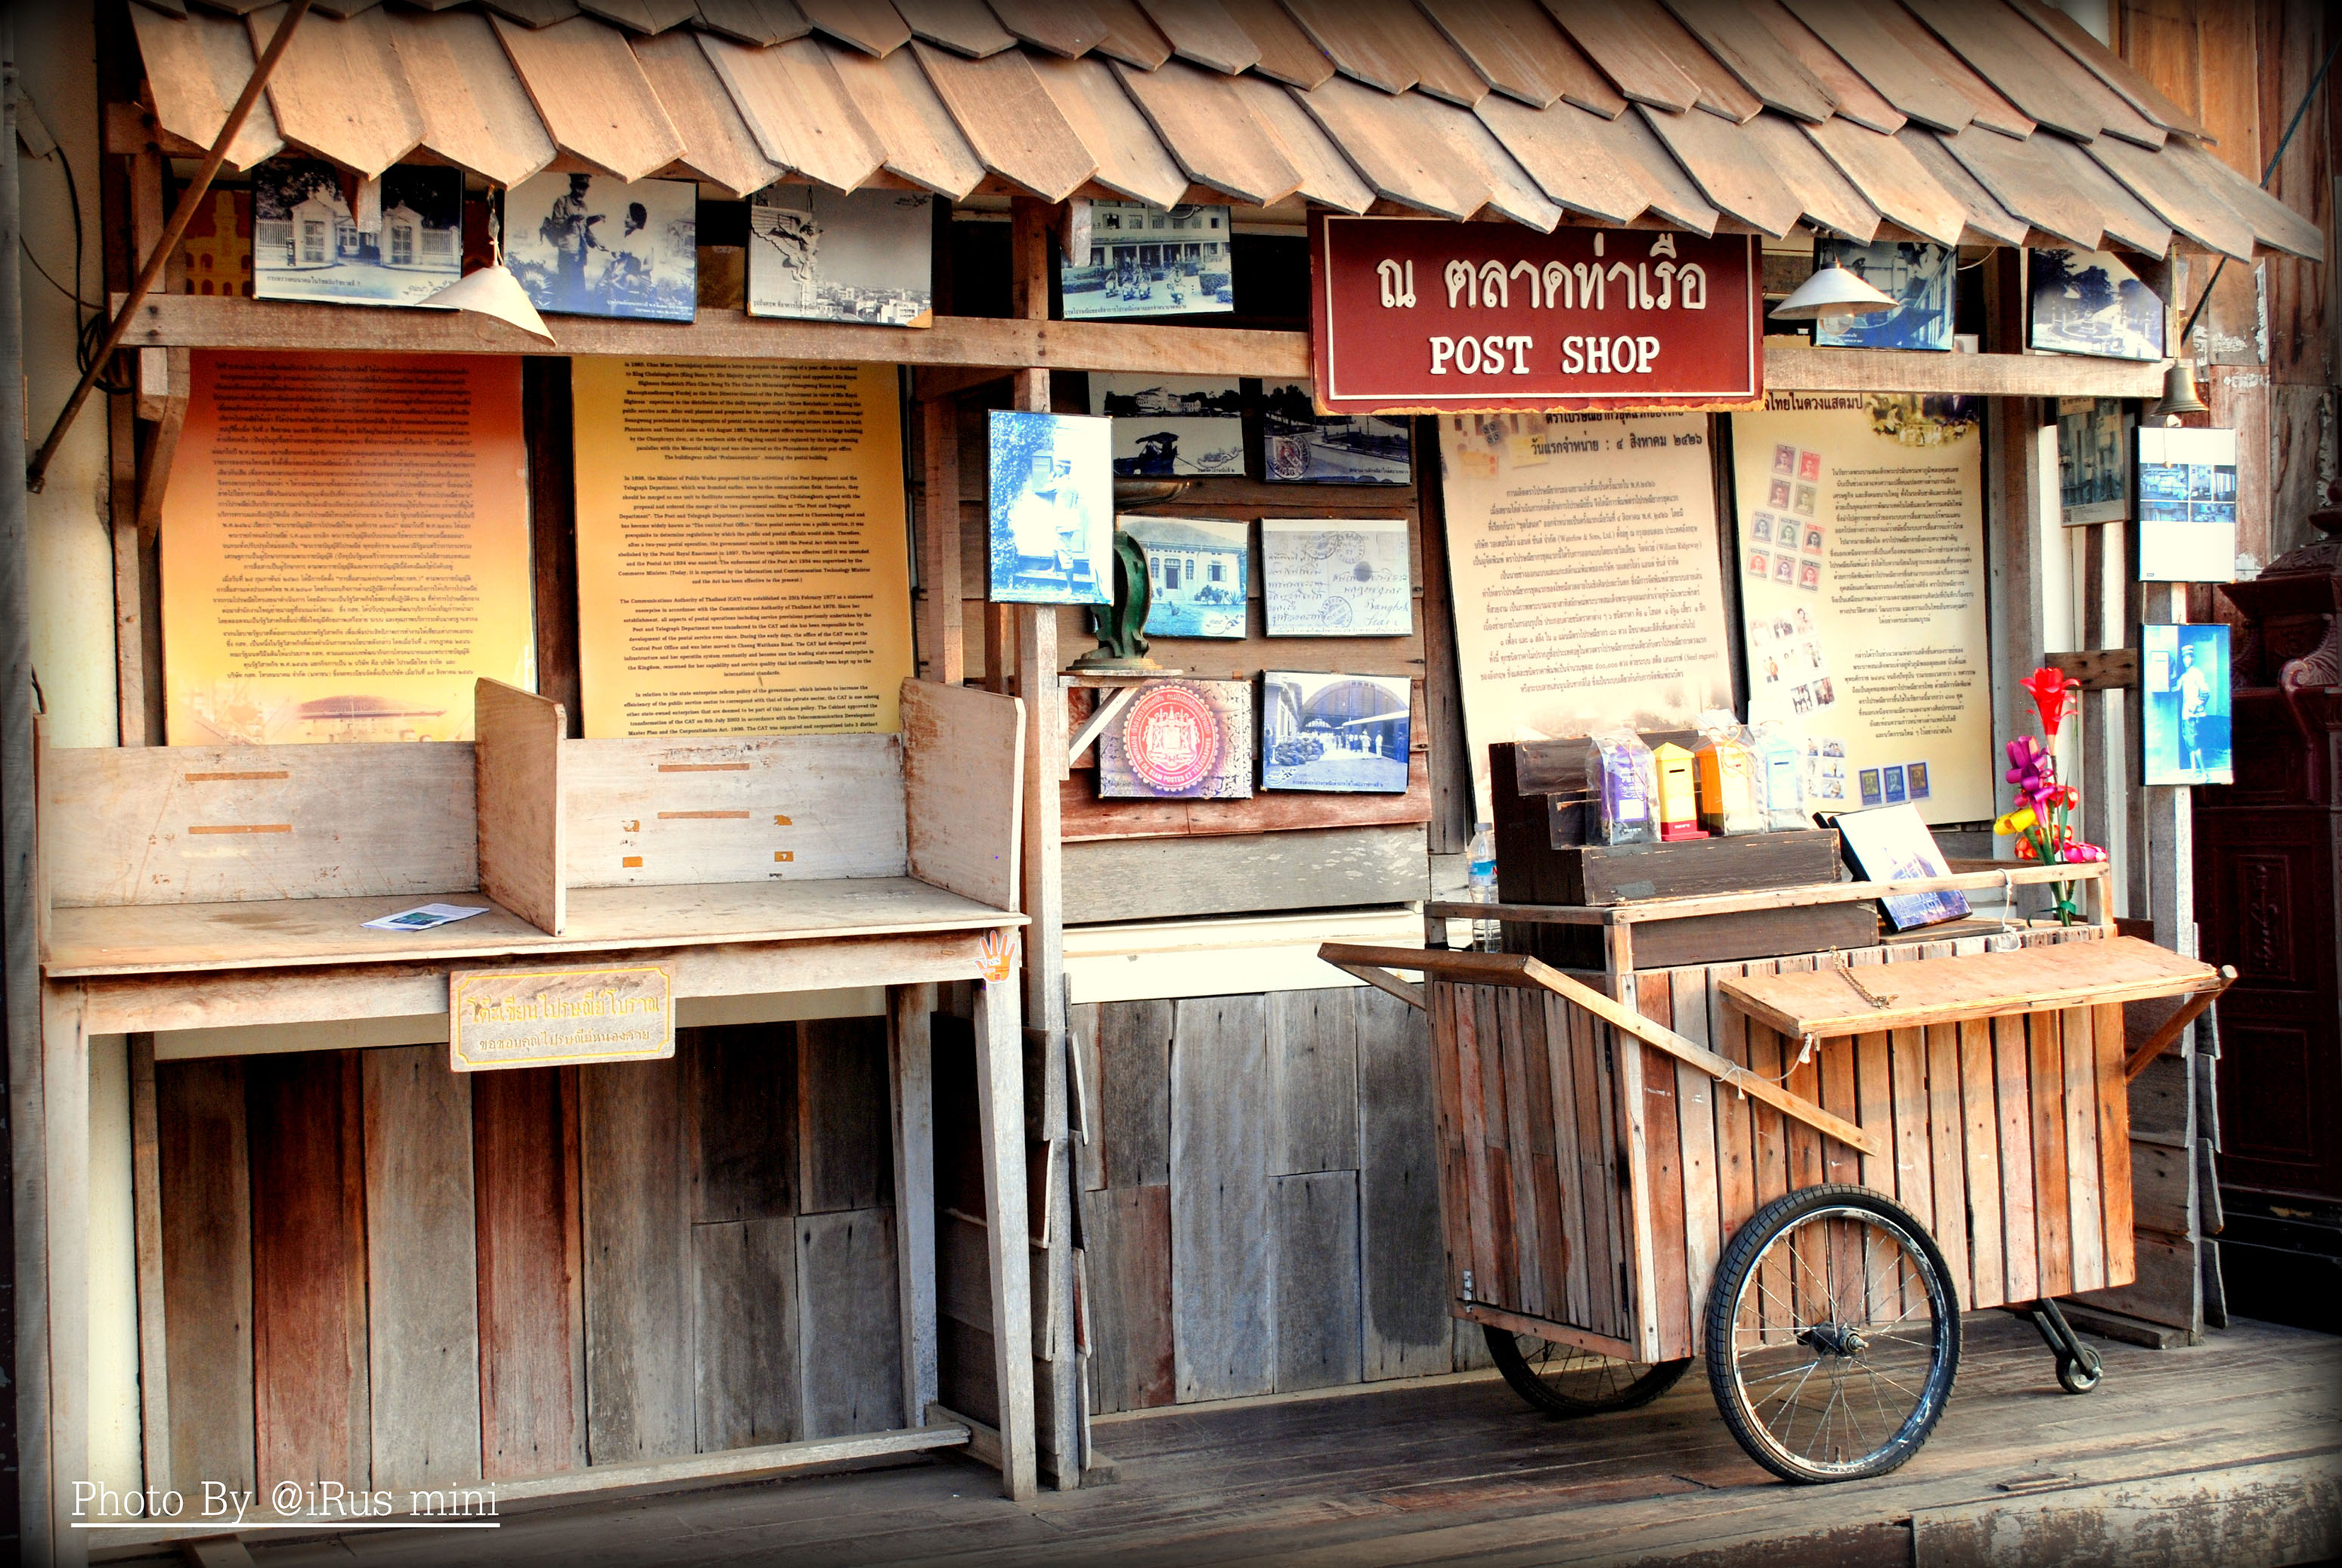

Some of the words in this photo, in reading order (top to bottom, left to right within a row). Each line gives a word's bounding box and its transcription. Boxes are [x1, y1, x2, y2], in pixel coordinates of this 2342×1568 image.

[1377, 259, 1417, 308] ณ
[1445, 232, 1706, 311] ตลาดท่าเรือ
[1430, 336, 1532, 374] POST
[1562, 336, 1660, 374] SHOP
[1630, 432, 1666, 449] สิงหาคม
